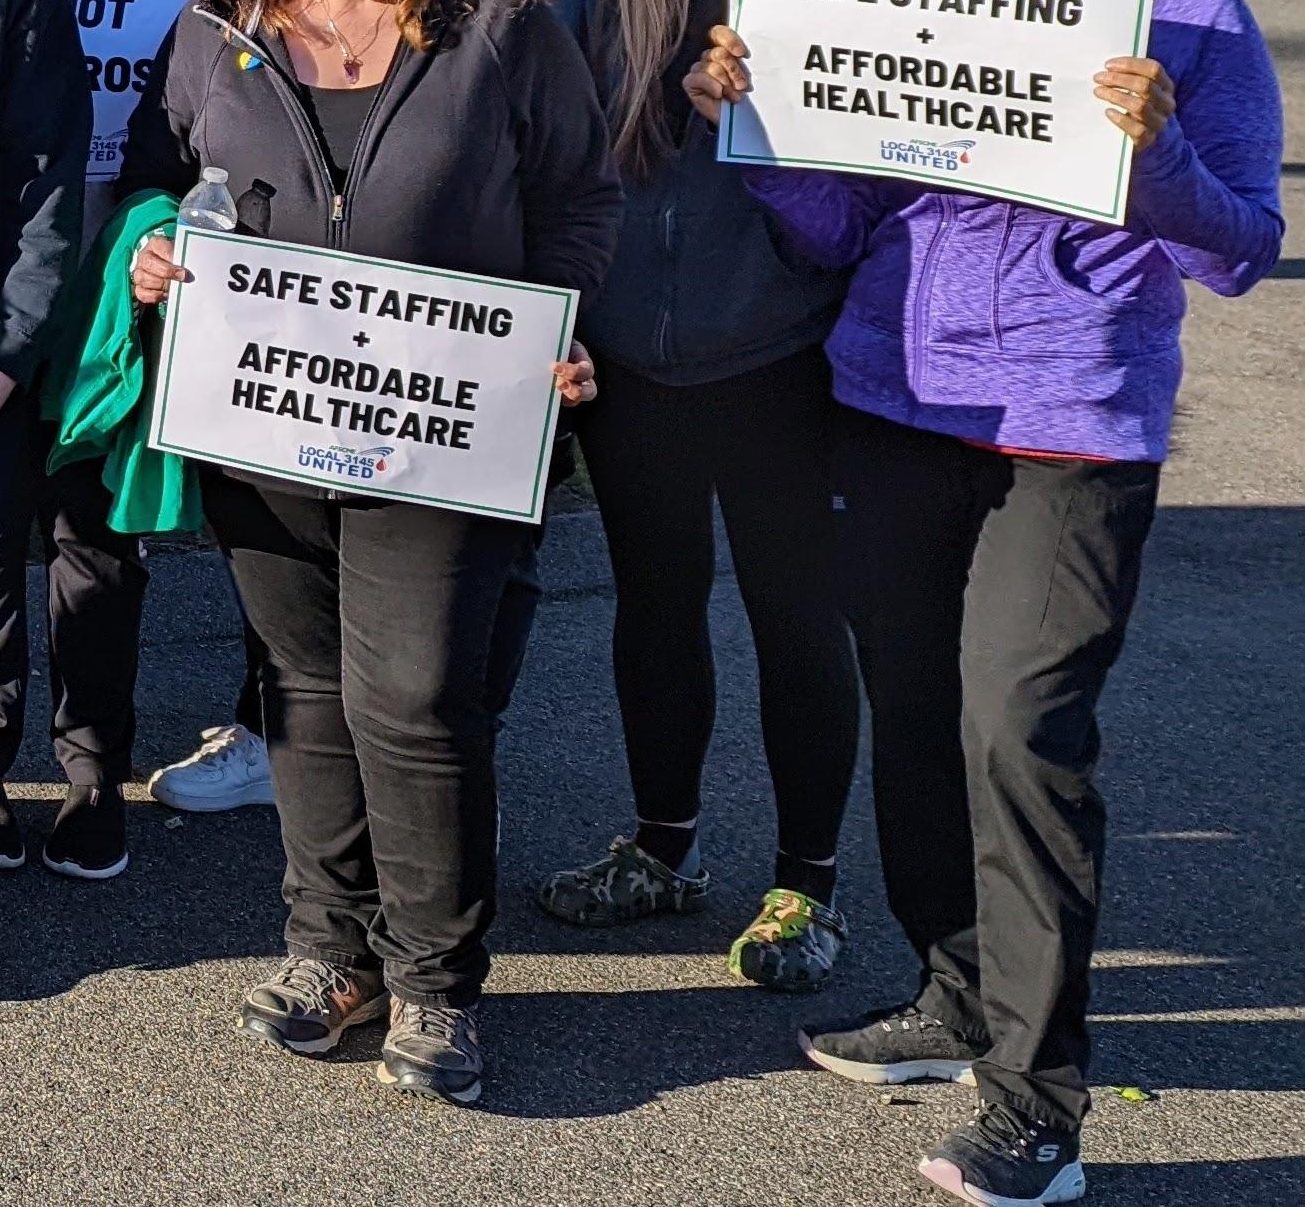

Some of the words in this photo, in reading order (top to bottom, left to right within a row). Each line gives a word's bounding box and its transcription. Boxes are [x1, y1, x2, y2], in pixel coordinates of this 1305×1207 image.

[916, 27, 935, 44] +
[85, 55, 155, 94] ROS
[803, 44, 1053, 104] AFFORDABLE
[803, 80, 1054, 143] HEALTHCARE
[92, 141, 118, 150] 3145
[880, 140, 924, 154] LOCAL
[926, 145, 958, 160] 3145
[880, 148, 958, 172] UNITED
[227, 263, 322, 306] SAFE
[329, 280, 514, 338] STAFFING
[352, 331, 370, 347] +
[237, 342, 480, 411] AFFORDABLE
[231, 378, 475, 451] HEALTHCARE
[298, 454, 374, 479] UNITED
[299, 445, 341, 462] LOCAL
[344, 454, 374, 467] 3145
